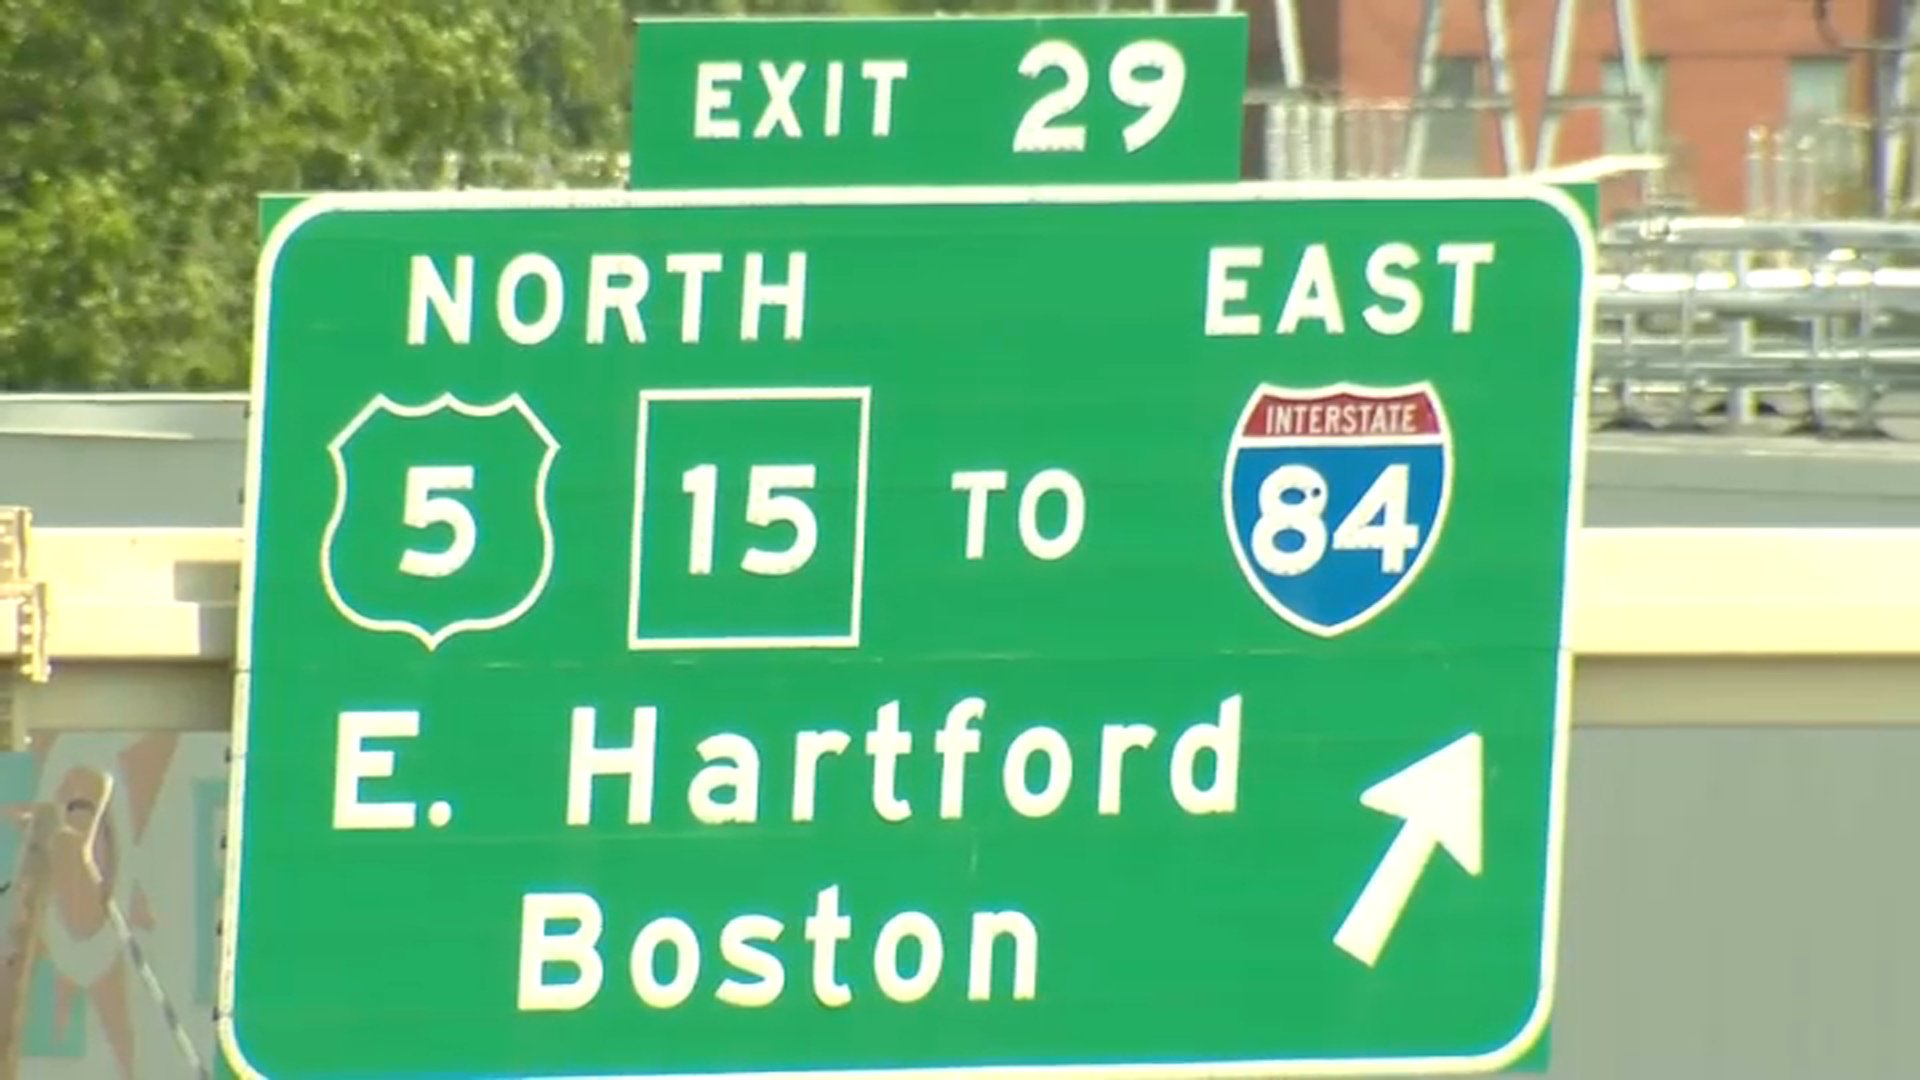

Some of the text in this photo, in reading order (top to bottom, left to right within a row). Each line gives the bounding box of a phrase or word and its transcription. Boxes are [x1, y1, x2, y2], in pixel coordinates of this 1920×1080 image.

[695, 40, 1186, 152] EXIT 29
[407, 252, 807, 345] NORTH
[1204, 243, 1495, 335] EAST
[1265, 404, 1418, 435] INTERSTATE
[399, 466, 476, 577] 5
[682, 465, 817, 575] 15
[952, 469, 1085, 560] TO
[1251, 463, 1420, 576] 84
[334, 695, 1242, 830] E. Hartford
[518, 886, 1038, 1011] Boston
